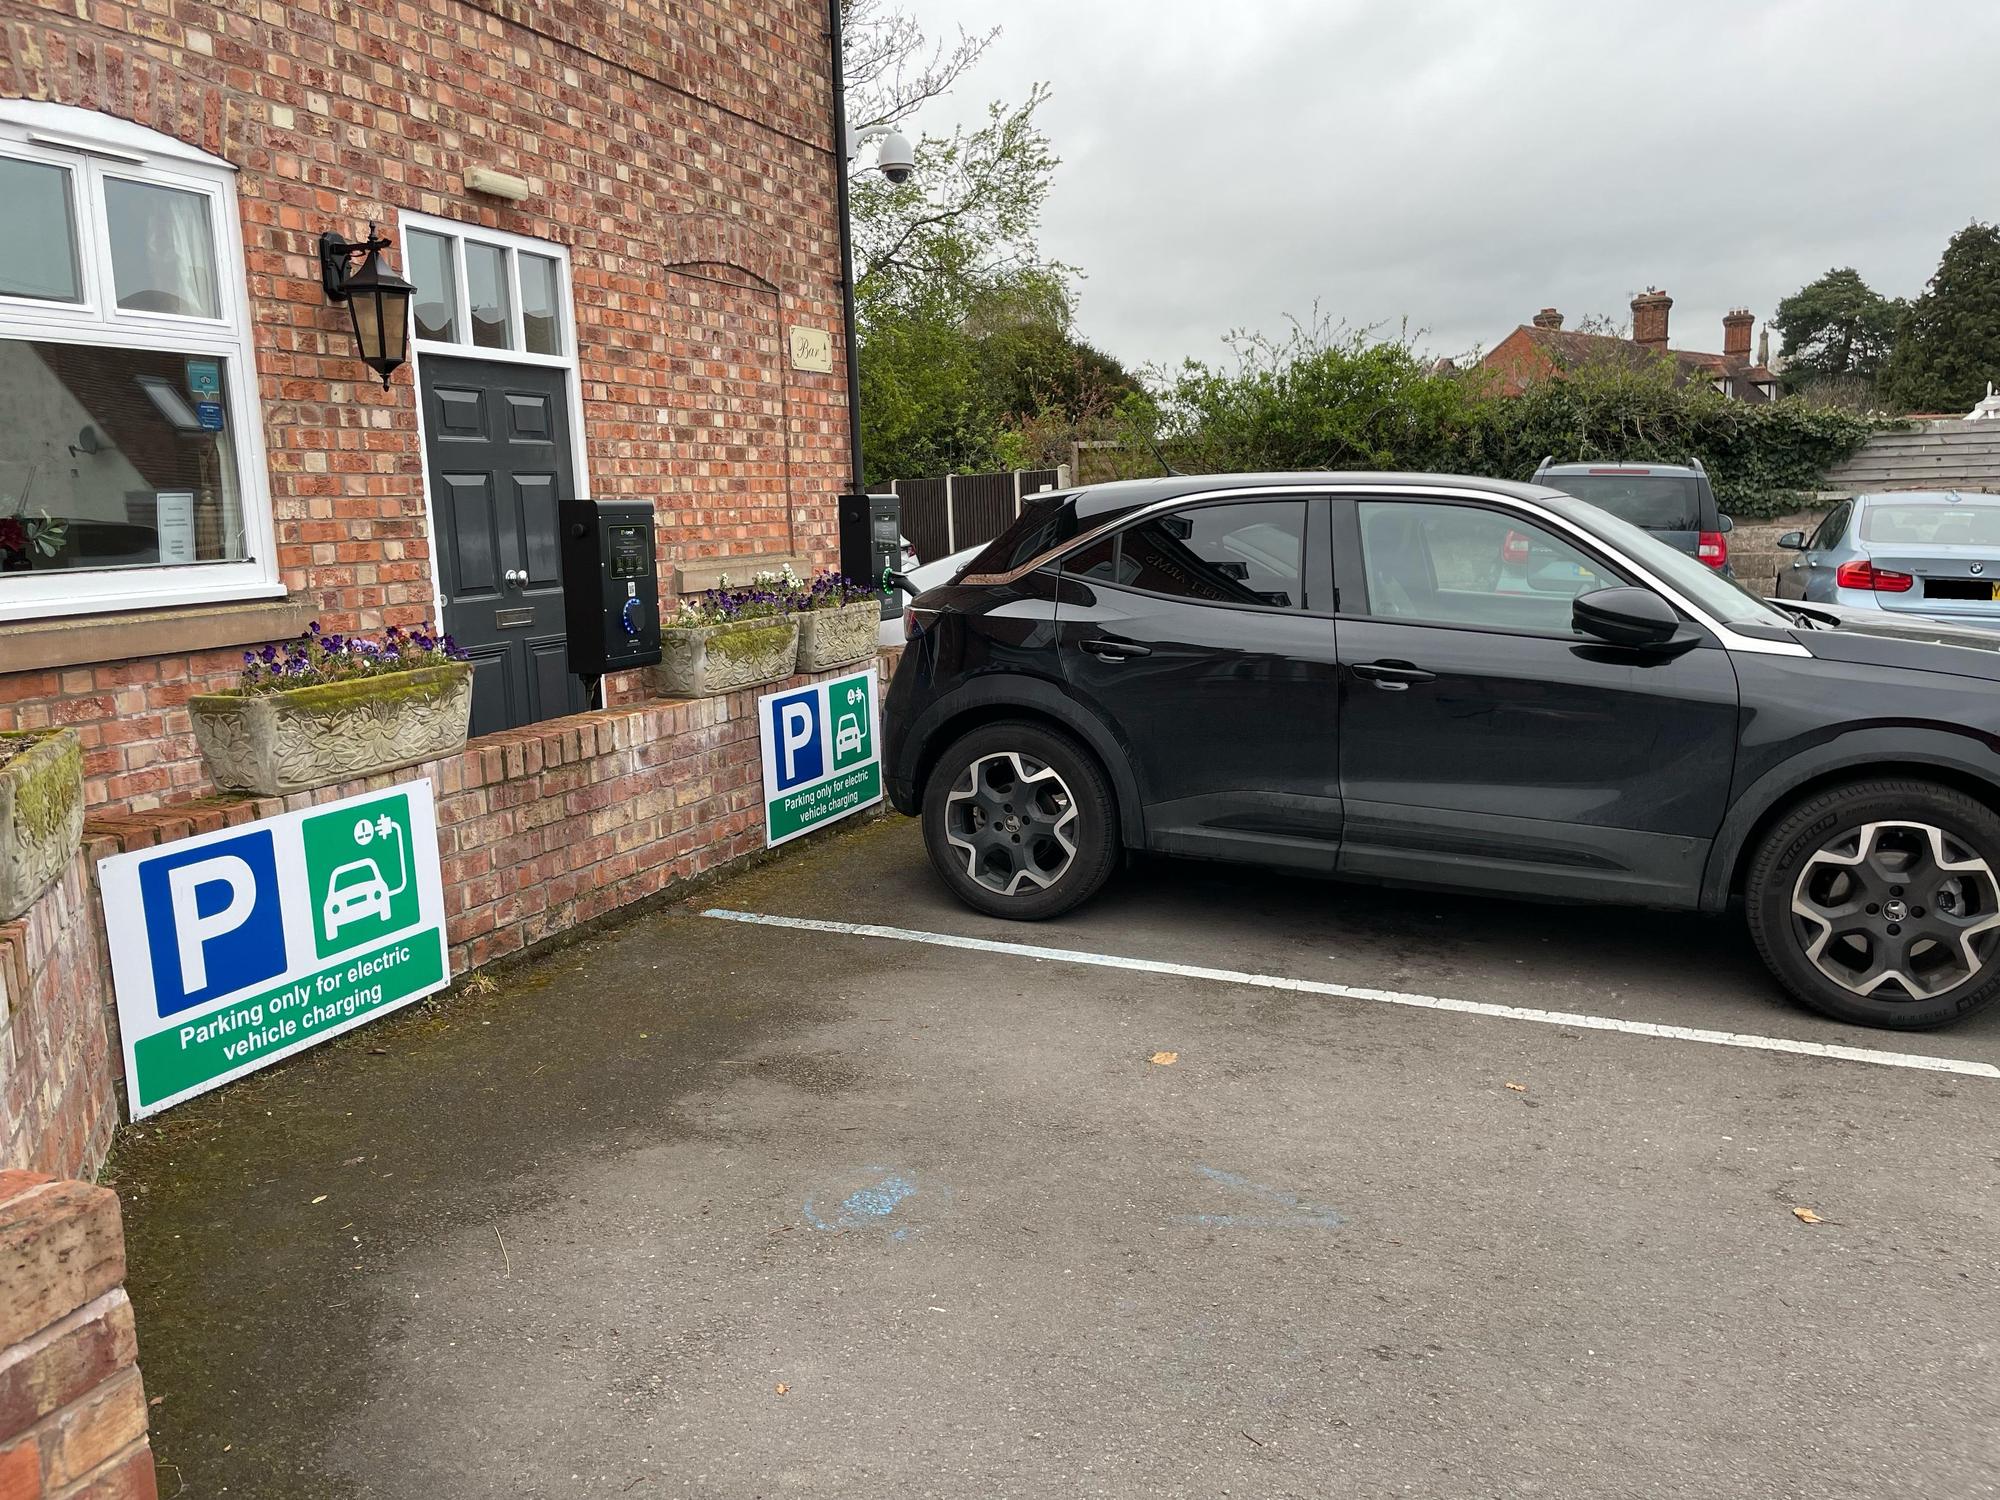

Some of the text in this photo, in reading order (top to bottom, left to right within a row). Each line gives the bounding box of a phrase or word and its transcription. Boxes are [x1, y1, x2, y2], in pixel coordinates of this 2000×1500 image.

[797, 336, 819, 359] Bar
[782, 702, 813, 780] P
[785, 770, 868, 811] Parking only for electric
[800, 791, 858, 822] vehicle charging
[168, 855, 257, 995] P
[180, 946, 410, 1050] Parking only for electric
[223, 984, 382, 1060] vehicle charging
